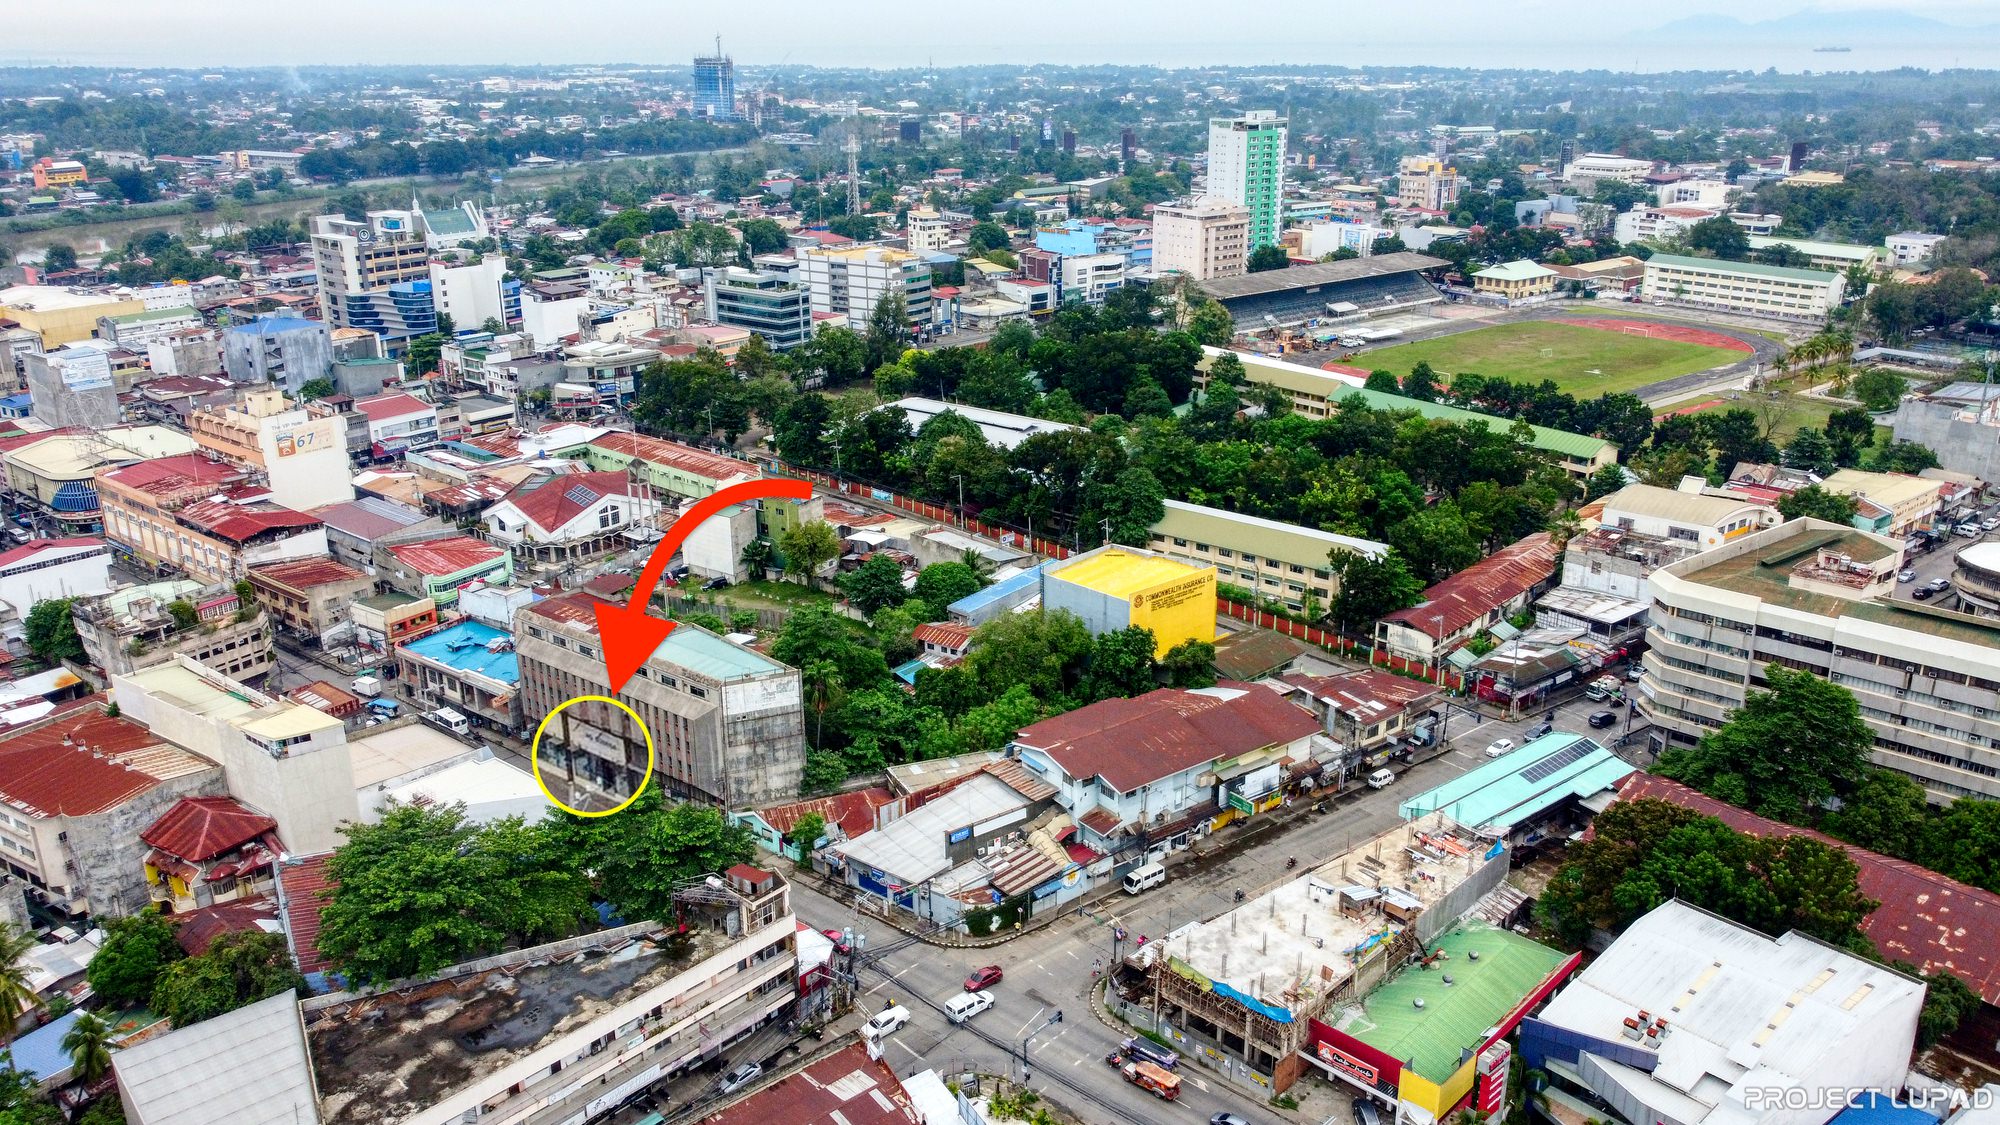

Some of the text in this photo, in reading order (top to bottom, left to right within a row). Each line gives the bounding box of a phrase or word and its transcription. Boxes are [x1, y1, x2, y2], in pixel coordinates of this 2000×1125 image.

[297, 432, 315, 448] 67
[1145, 584, 1182, 602] COMMONWEALTH
[1182, 577, 1206, 590] INSURANCE
